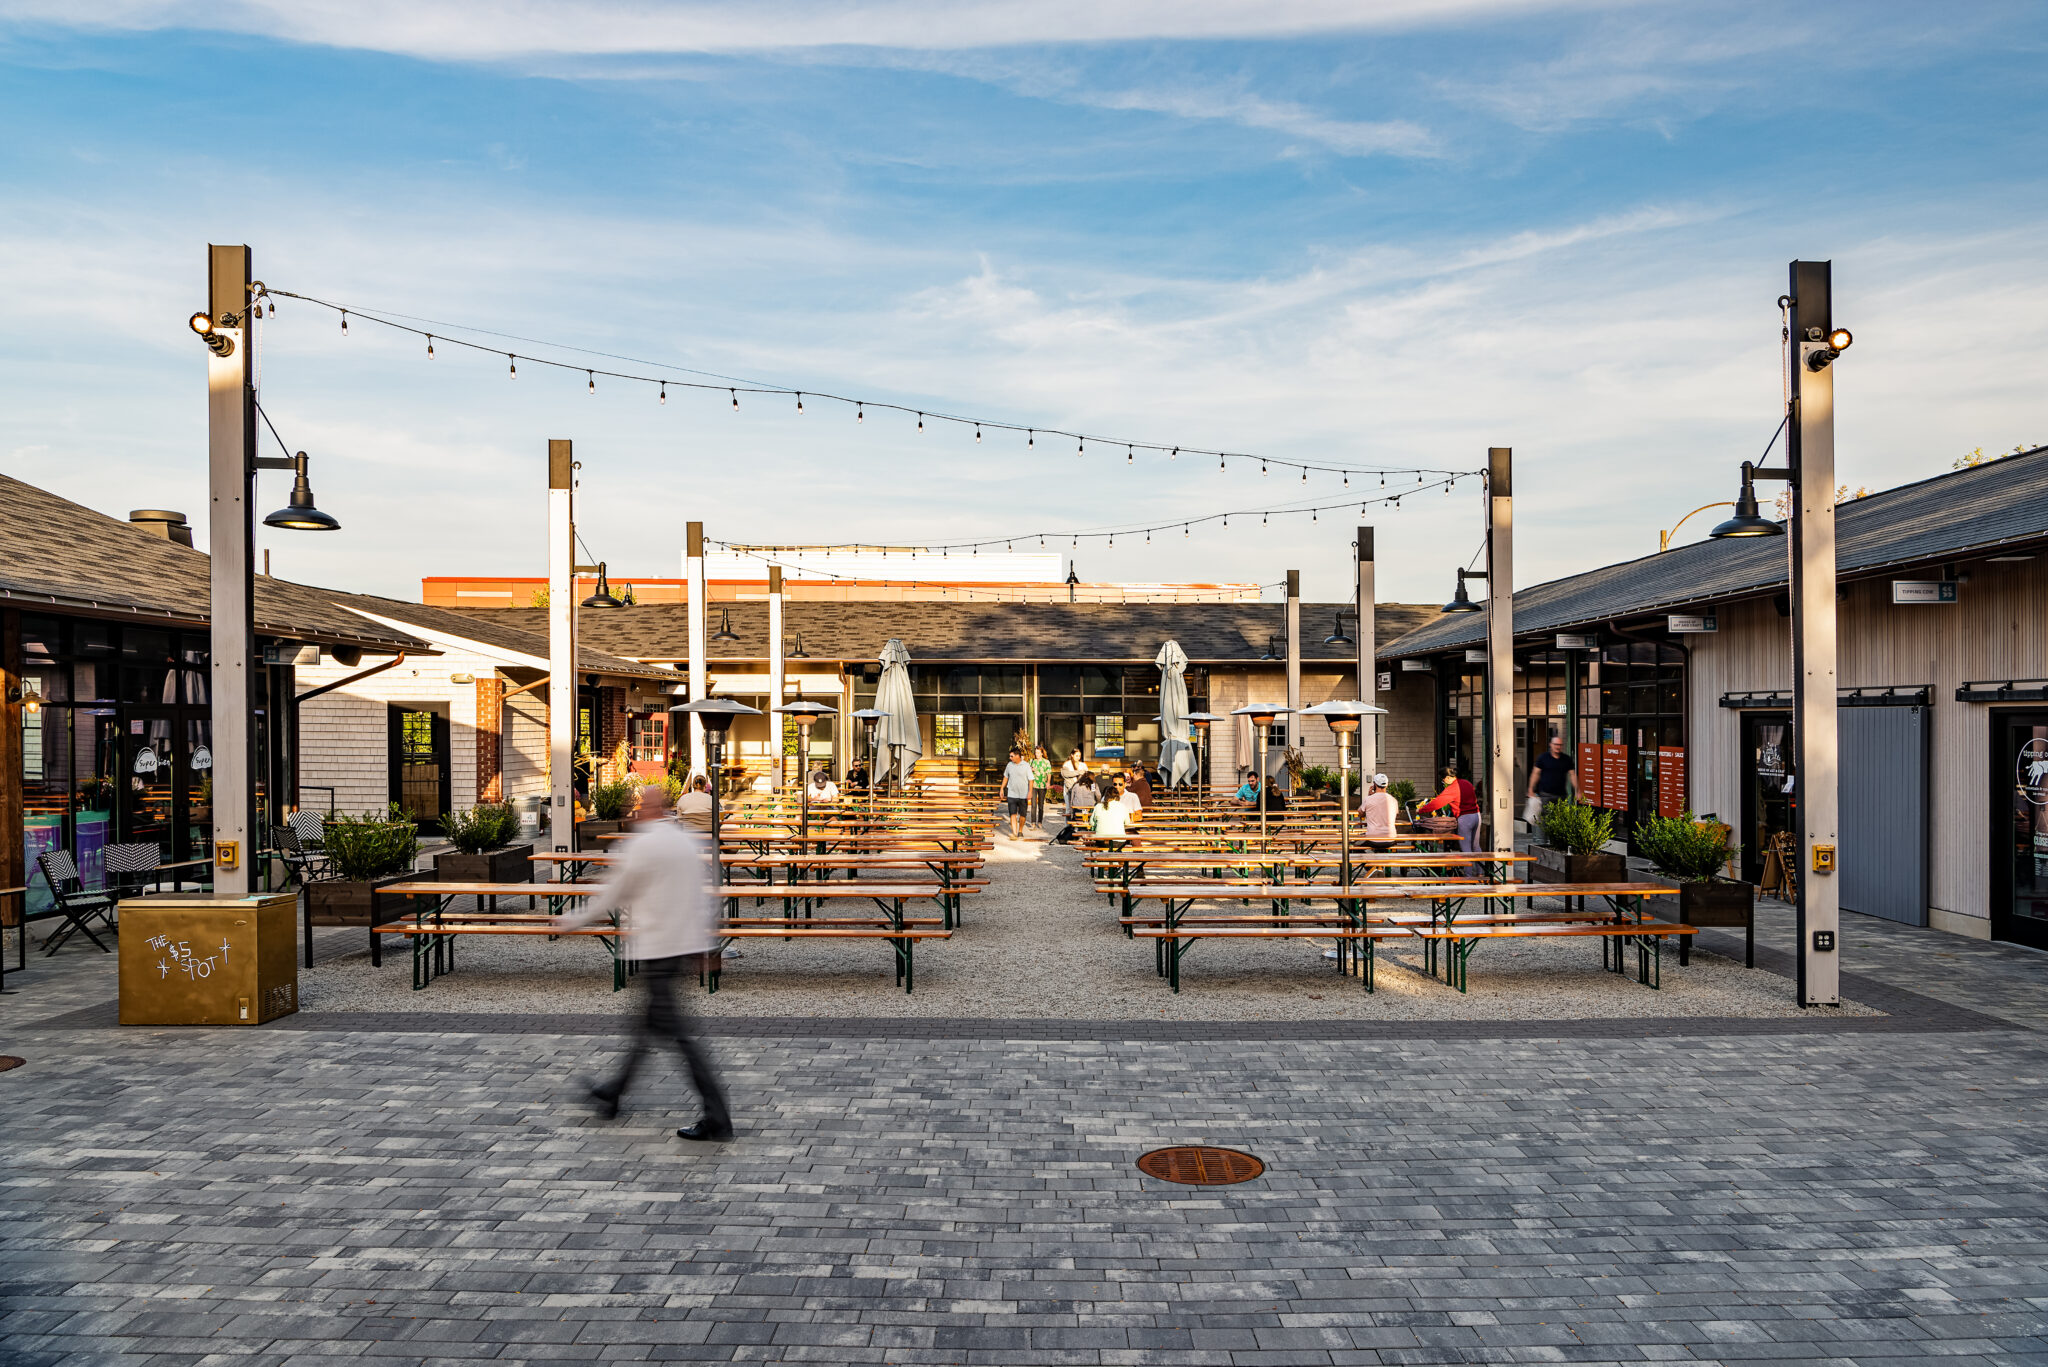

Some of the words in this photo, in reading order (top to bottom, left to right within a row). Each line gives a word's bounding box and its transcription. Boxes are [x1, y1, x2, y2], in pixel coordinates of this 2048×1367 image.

[2023, 749, 2044, 759] tipping
[139, 759, 156, 769] Super
[195, 756, 210, 766] Super
[144, 934, 170, 951] THE
[169, 941, 192, 961] $5
[180, 955, 219, 981] SPOT
